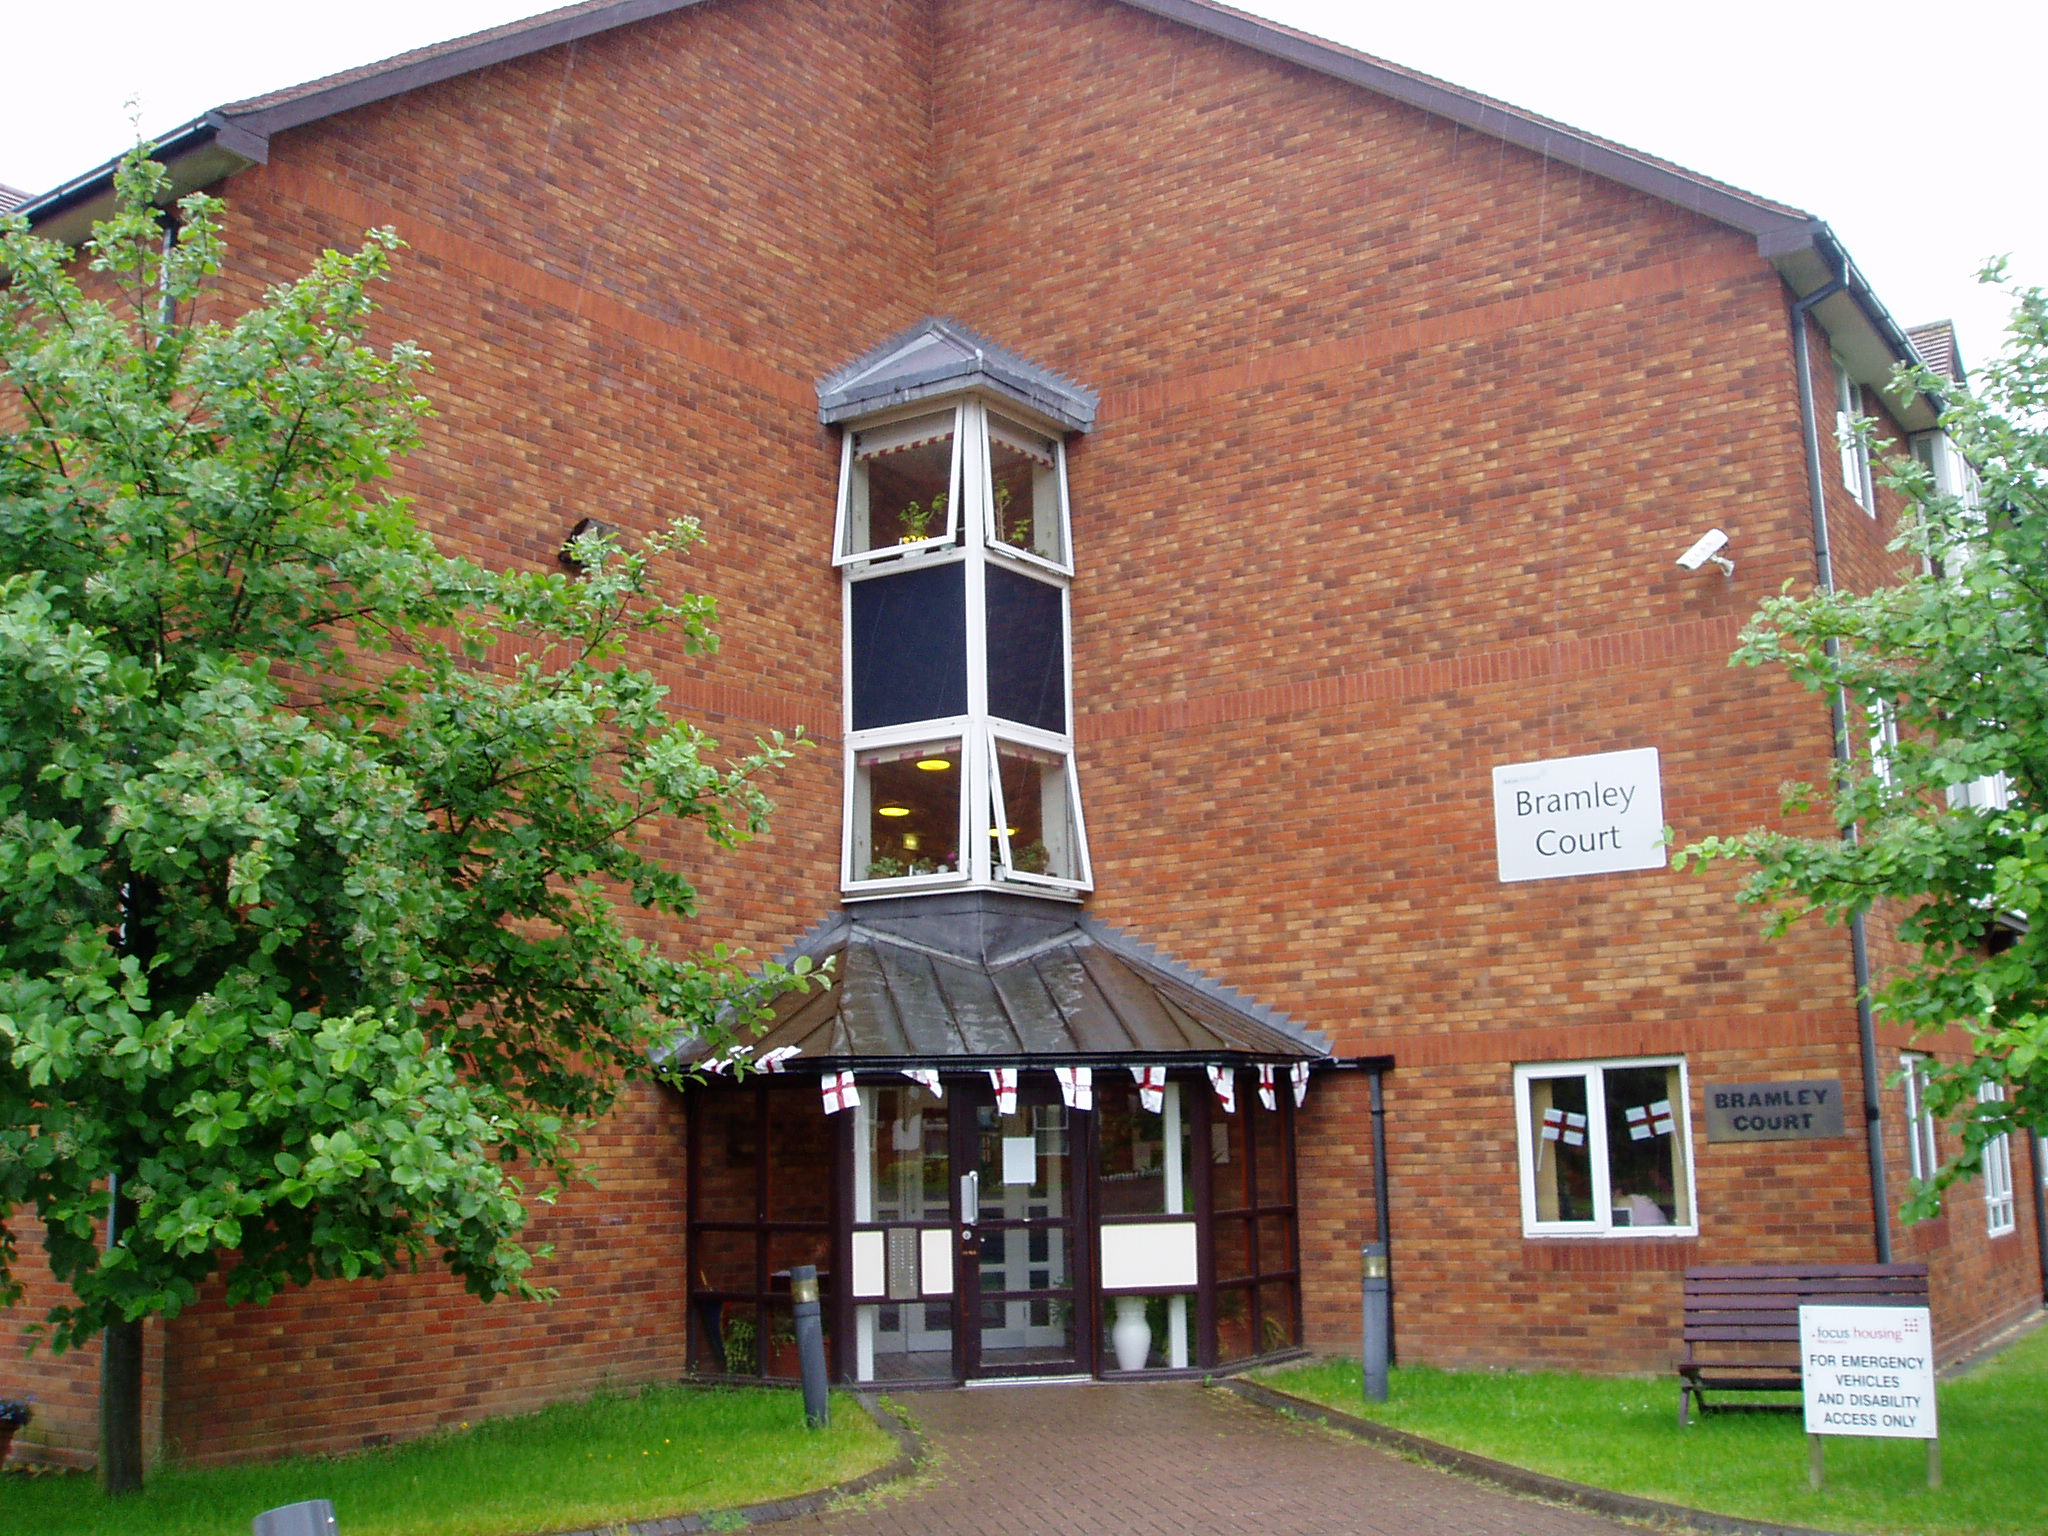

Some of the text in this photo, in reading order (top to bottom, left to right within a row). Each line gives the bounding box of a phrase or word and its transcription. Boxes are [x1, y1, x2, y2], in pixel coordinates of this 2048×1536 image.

[1517, 782, 1635, 816] Bramley
[1536, 826, 1622, 856] Court
[1714, 1089, 1828, 1108] BRAMLEY
[1733, 1113, 1813, 1131] COURT
[1817, 1327, 1850, 1339] focus
[1853, 1326, 1903, 1343] housing
[1810, 1354, 1925, 1369] FOR EMERGENCY
[1836, 1374, 1900, 1388] VEHICLES
[1817, 1393, 1921, 1408] AND DISABILITY
[1824, 1413, 1917, 1428] ACCESS ONLY
